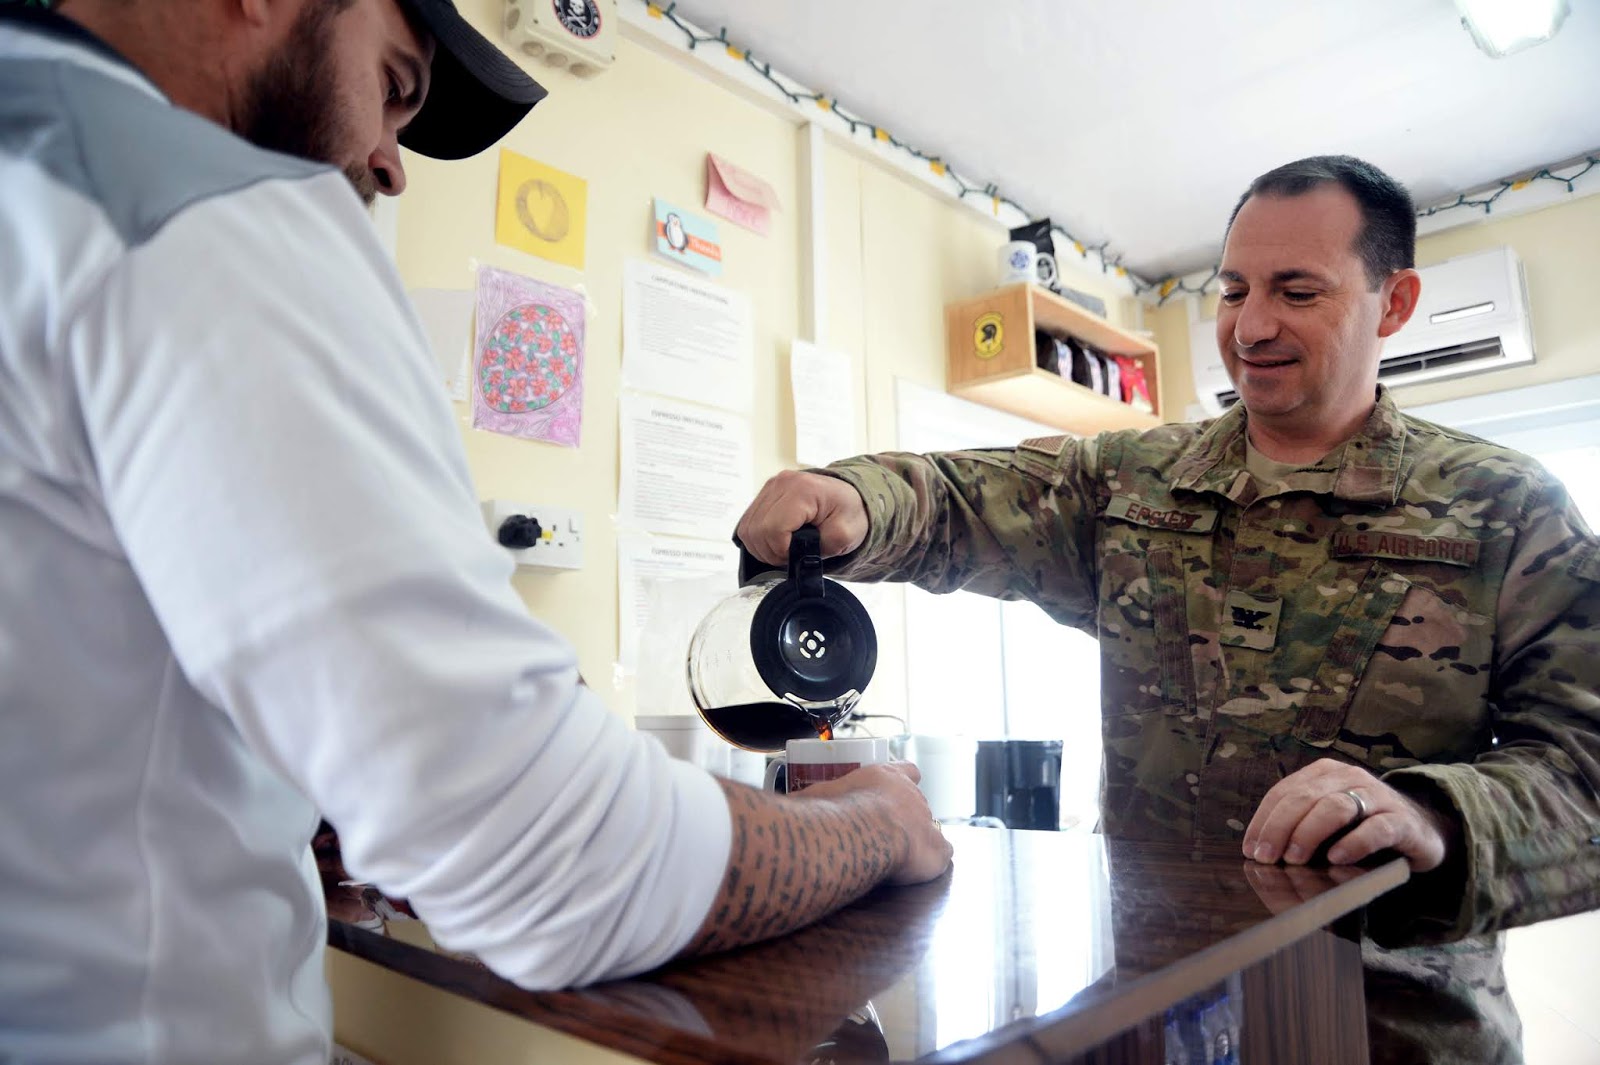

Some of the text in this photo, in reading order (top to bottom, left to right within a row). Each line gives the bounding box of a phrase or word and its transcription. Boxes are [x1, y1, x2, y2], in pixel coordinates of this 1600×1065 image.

[1337, 534, 1476, 564] U.S. AIR FORCE
